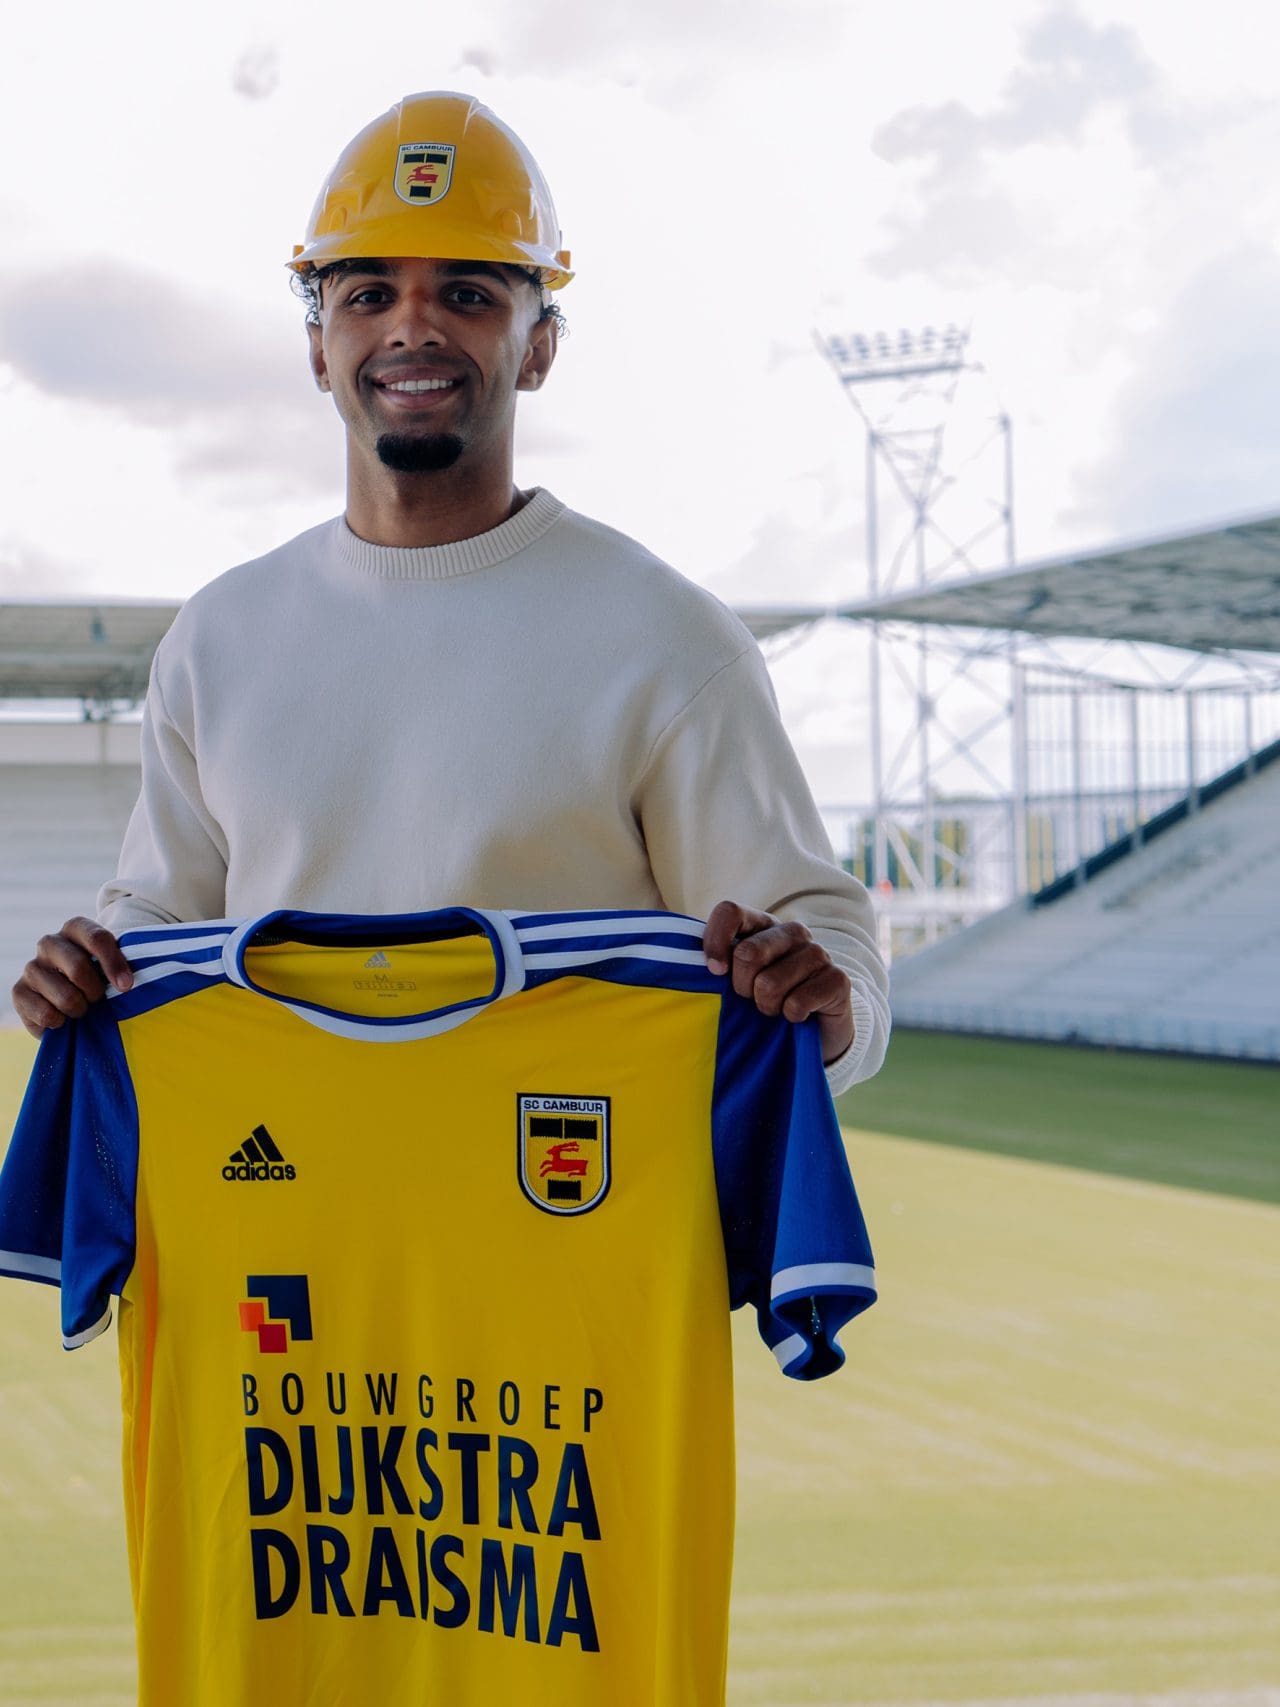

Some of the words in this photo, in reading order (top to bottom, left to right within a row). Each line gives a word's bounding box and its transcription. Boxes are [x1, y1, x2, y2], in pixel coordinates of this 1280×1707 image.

[524, 1099, 539, 1109] SC
[543, 1100, 603, 1112] CAMBUUR
[222, 1161, 296, 1181] adidas
[242, 1372, 603, 1433] BOUWGROEP
[245, 1425, 601, 1541] DIJKSTRA
[250, 1524, 601, 1653] DRAISMA
